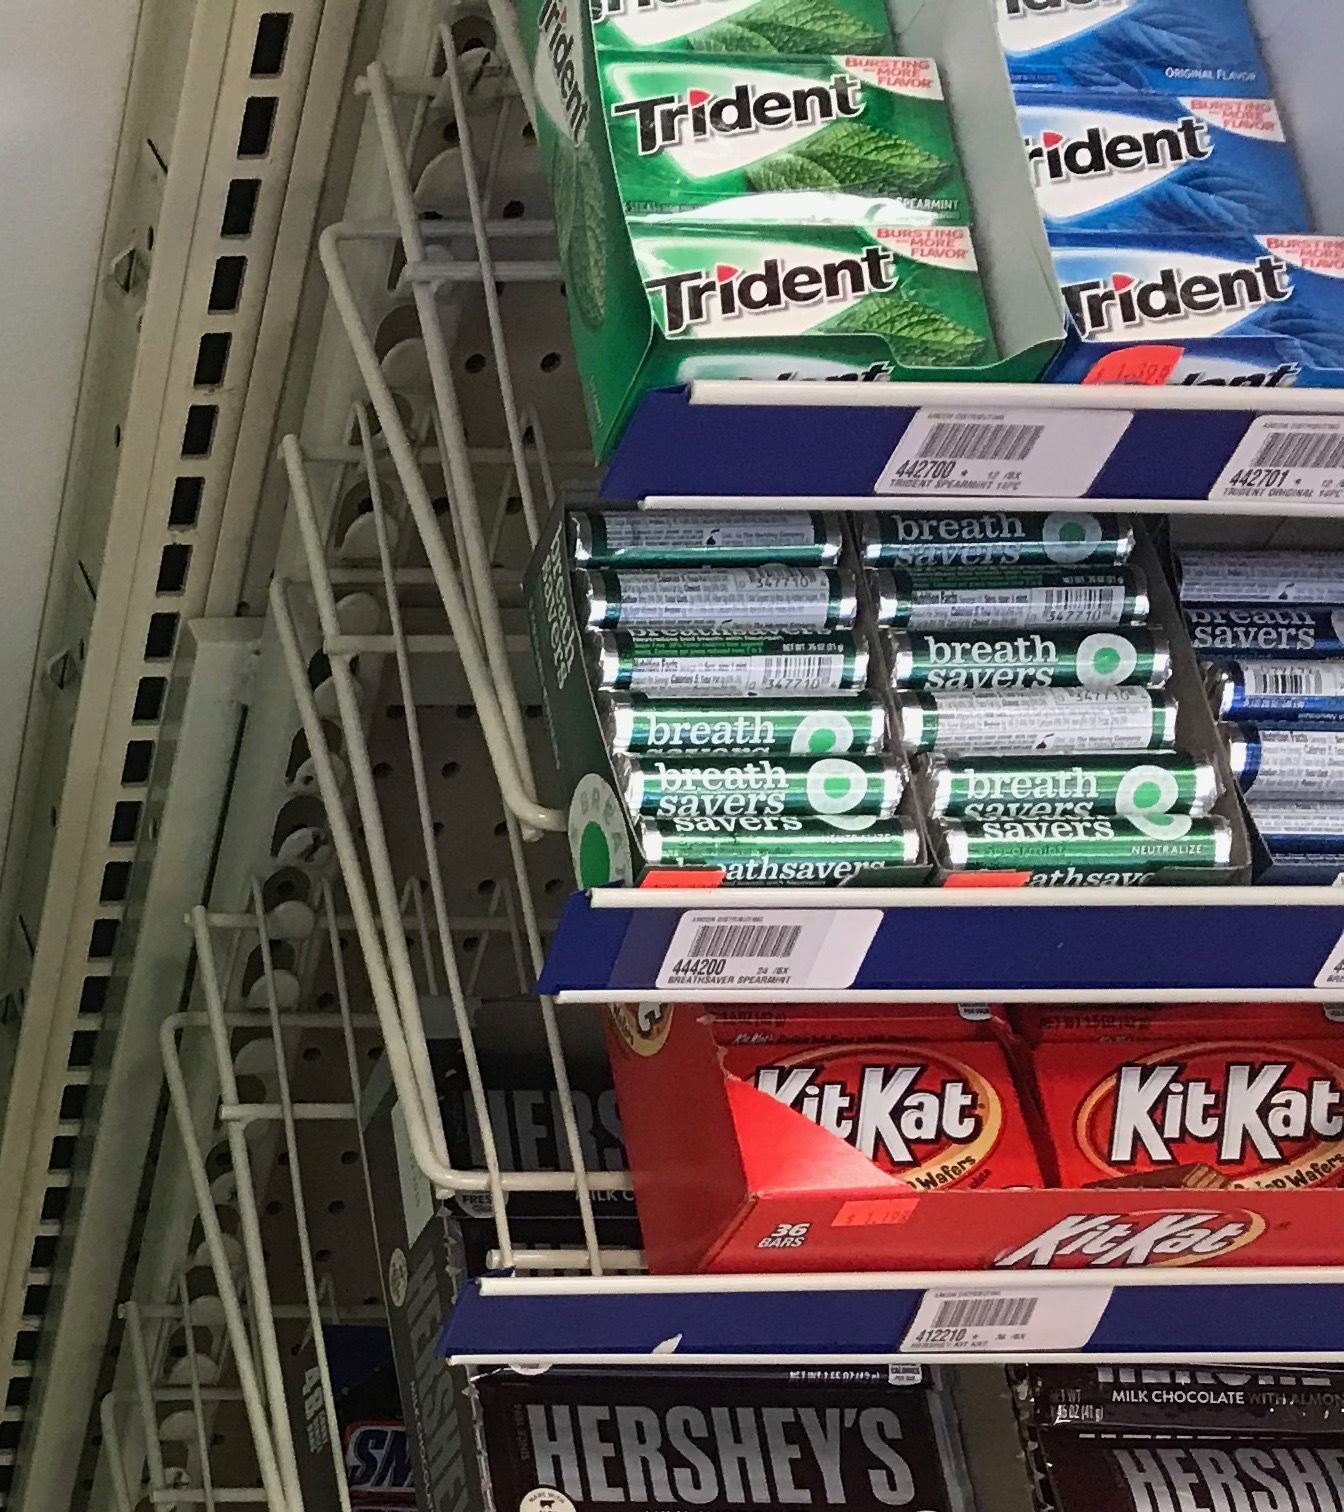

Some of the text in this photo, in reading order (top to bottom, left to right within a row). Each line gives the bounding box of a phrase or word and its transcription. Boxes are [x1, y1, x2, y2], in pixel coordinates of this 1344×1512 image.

[845, 57, 930, 69] BURSTING
[877, 67, 921, 77] MORE
[877, 77, 933, 89] FLAVOR
[1165, 66, 1256, 82] ORIGINAL FLAVOR
[615, 75, 864, 156] Trident
[876, 227, 964, 241] BURSTING
[910, 239, 957, 250] MORE
[911, 248, 968, 260] FLAVOR
[645, 247, 899, 335] Trident
[894, 459, 955, 479] 442700
[1228, 468, 1288, 487] 442701
[889, 478, 932, 489] TRIDENT
[892, 513, 1026, 541] breath
[894, 544, 1021, 566] savers
[1193, 624, 1317, 651] savers
[924, 634, 1059, 665] breath
[925, 665, 1055, 691] savers
[647, 714, 776, 746] breath
[654, 760, 790, 791] breath
[964, 767, 1099, 800] breath
[655, 789, 787, 818] savers
[983, 819, 1115, 842] savers
[672, 957, 728, 977] 444200
[666, 975, 792, 986] BREATHSAVER SPEARMINT
[771, 1222, 812, 1238] 36
[757, 1236, 806, 1248] BARS
[915, 1328, 967, 1344] 412210
[525, 1403, 916, 1506] HERSHEY'S
